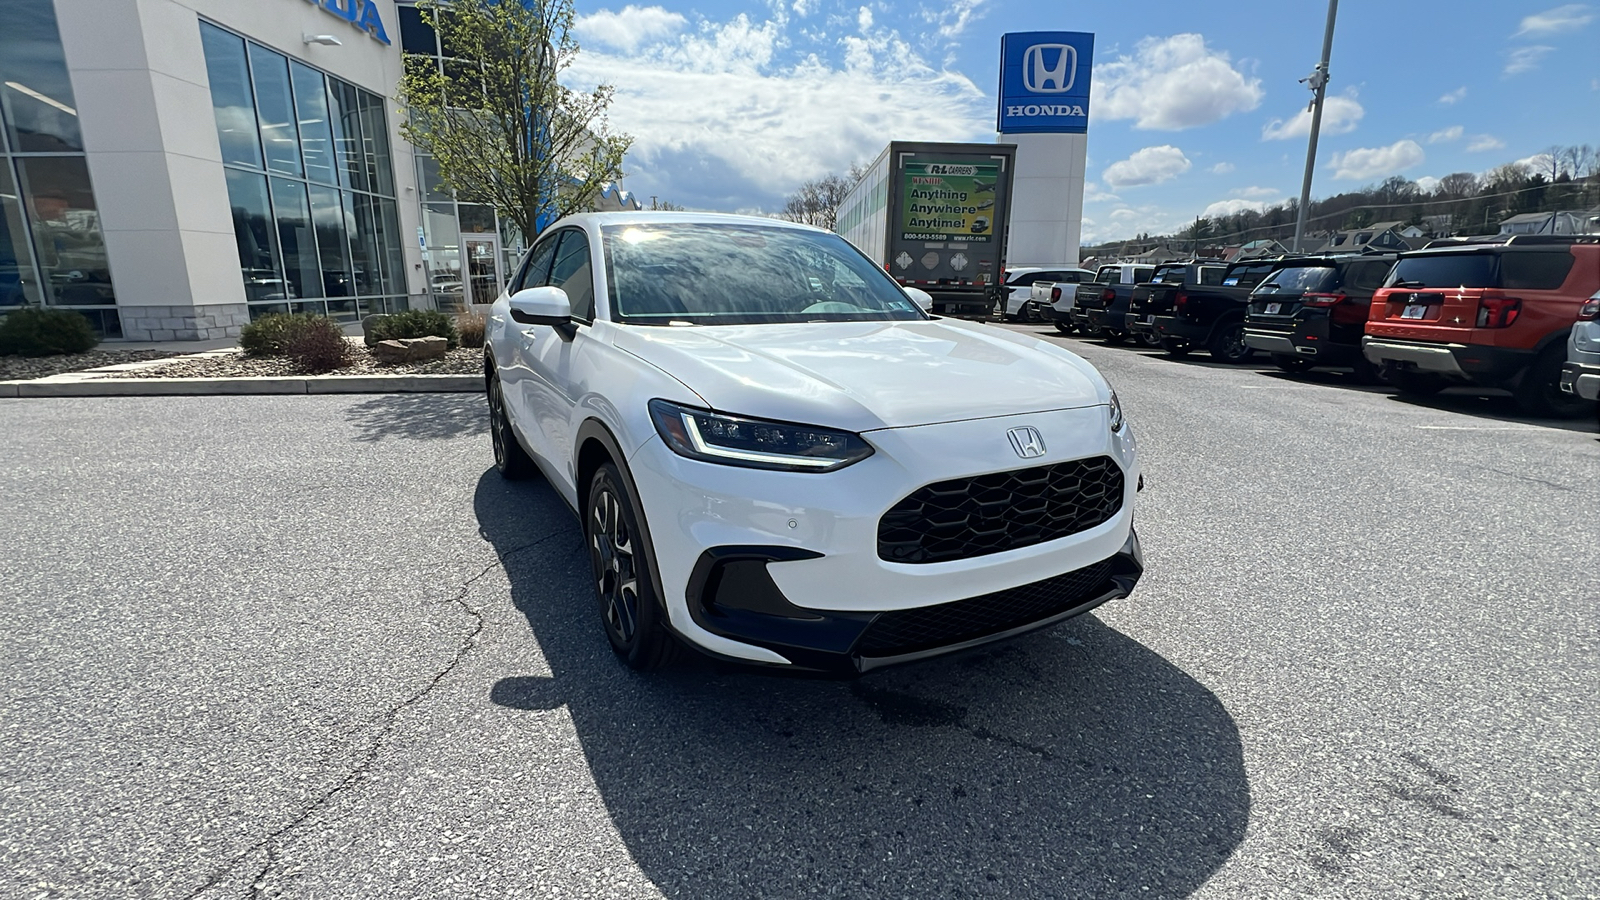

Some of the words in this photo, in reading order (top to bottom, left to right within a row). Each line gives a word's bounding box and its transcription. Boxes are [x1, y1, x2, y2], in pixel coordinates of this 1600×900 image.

[304, 0, 391, 46] DA
[1006, 105, 1086, 117] HONDA
[948, 166, 972, 175] CARRIERS
[911, 189, 967, 201] Anything
[910, 203, 976, 214] Anywhere
[909, 218, 966, 228] Anytime!
